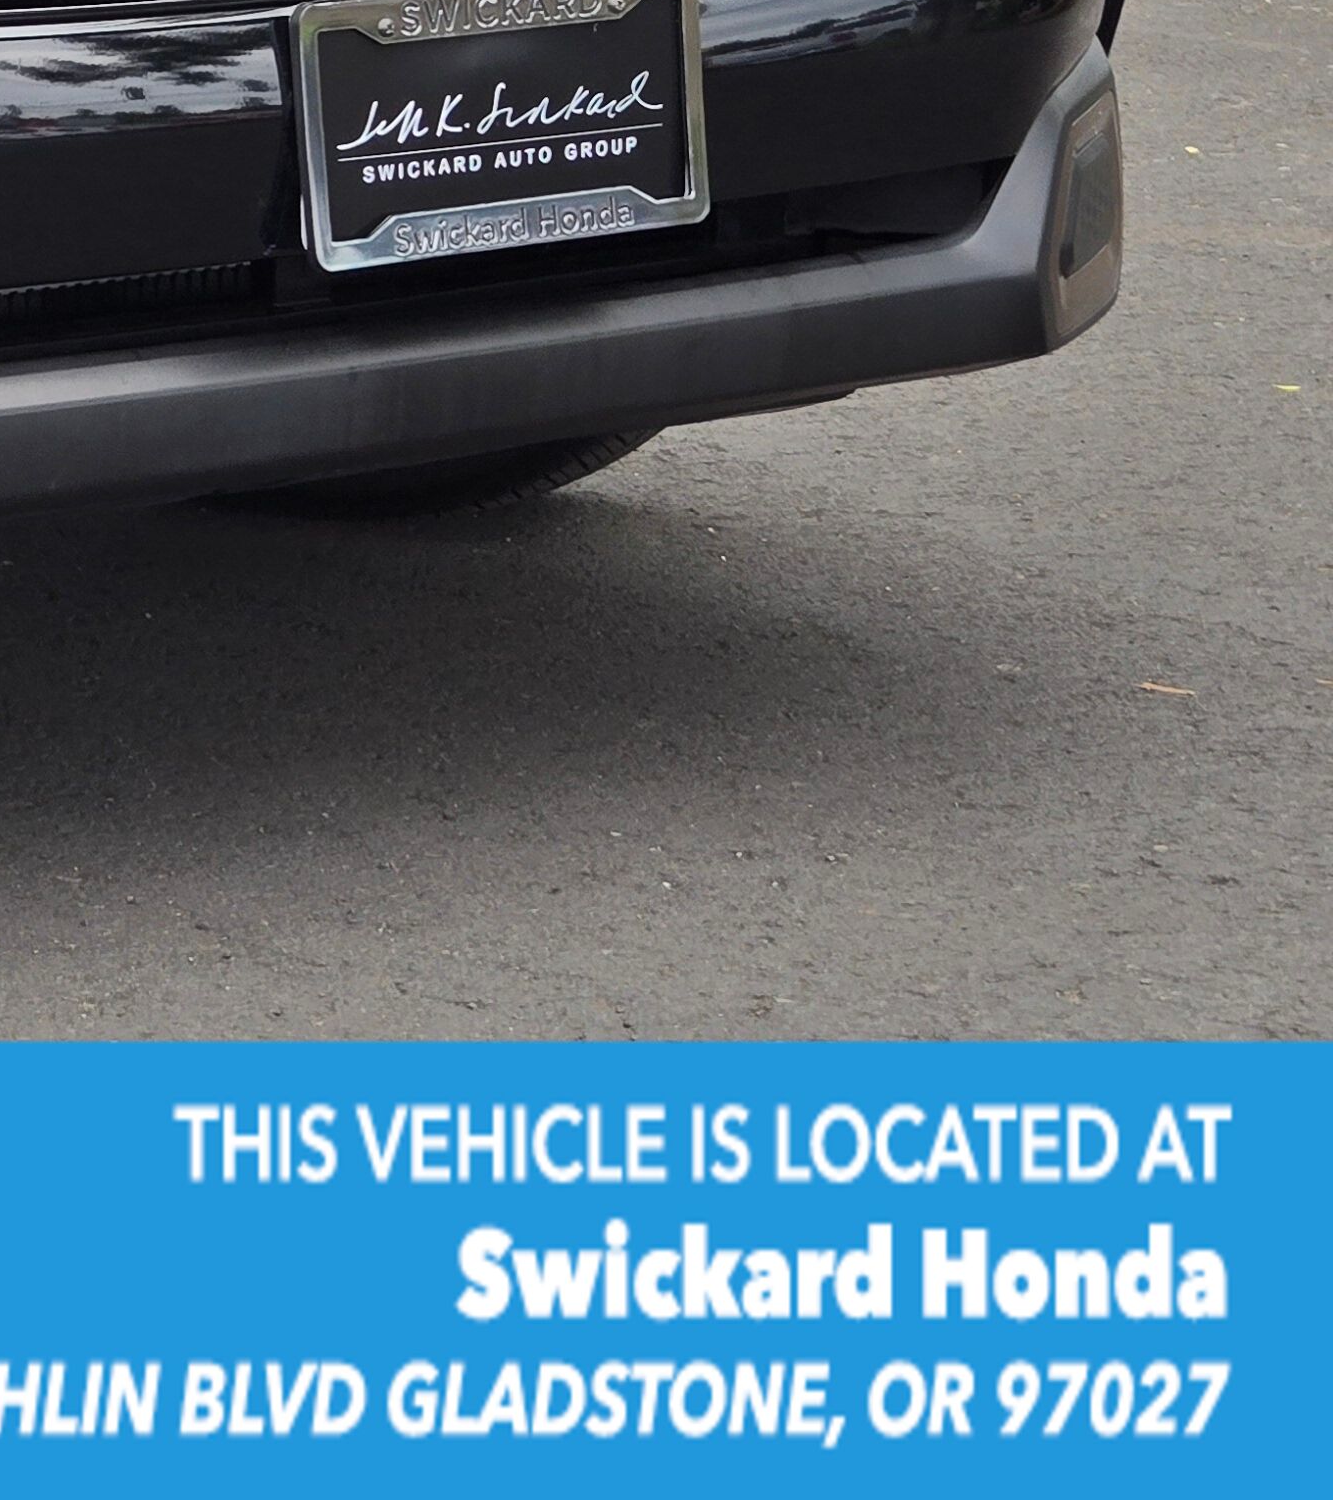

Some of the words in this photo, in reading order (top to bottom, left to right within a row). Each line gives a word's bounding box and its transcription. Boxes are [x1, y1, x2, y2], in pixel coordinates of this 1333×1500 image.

[362, 153, 482, 184] SWICKARD
[494, 145, 553, 180] AUTO
[564, 136, 639, 162] GROUP
[393, 209, 530, 259] Swickard
[536, 196, 635, 238] Honda
